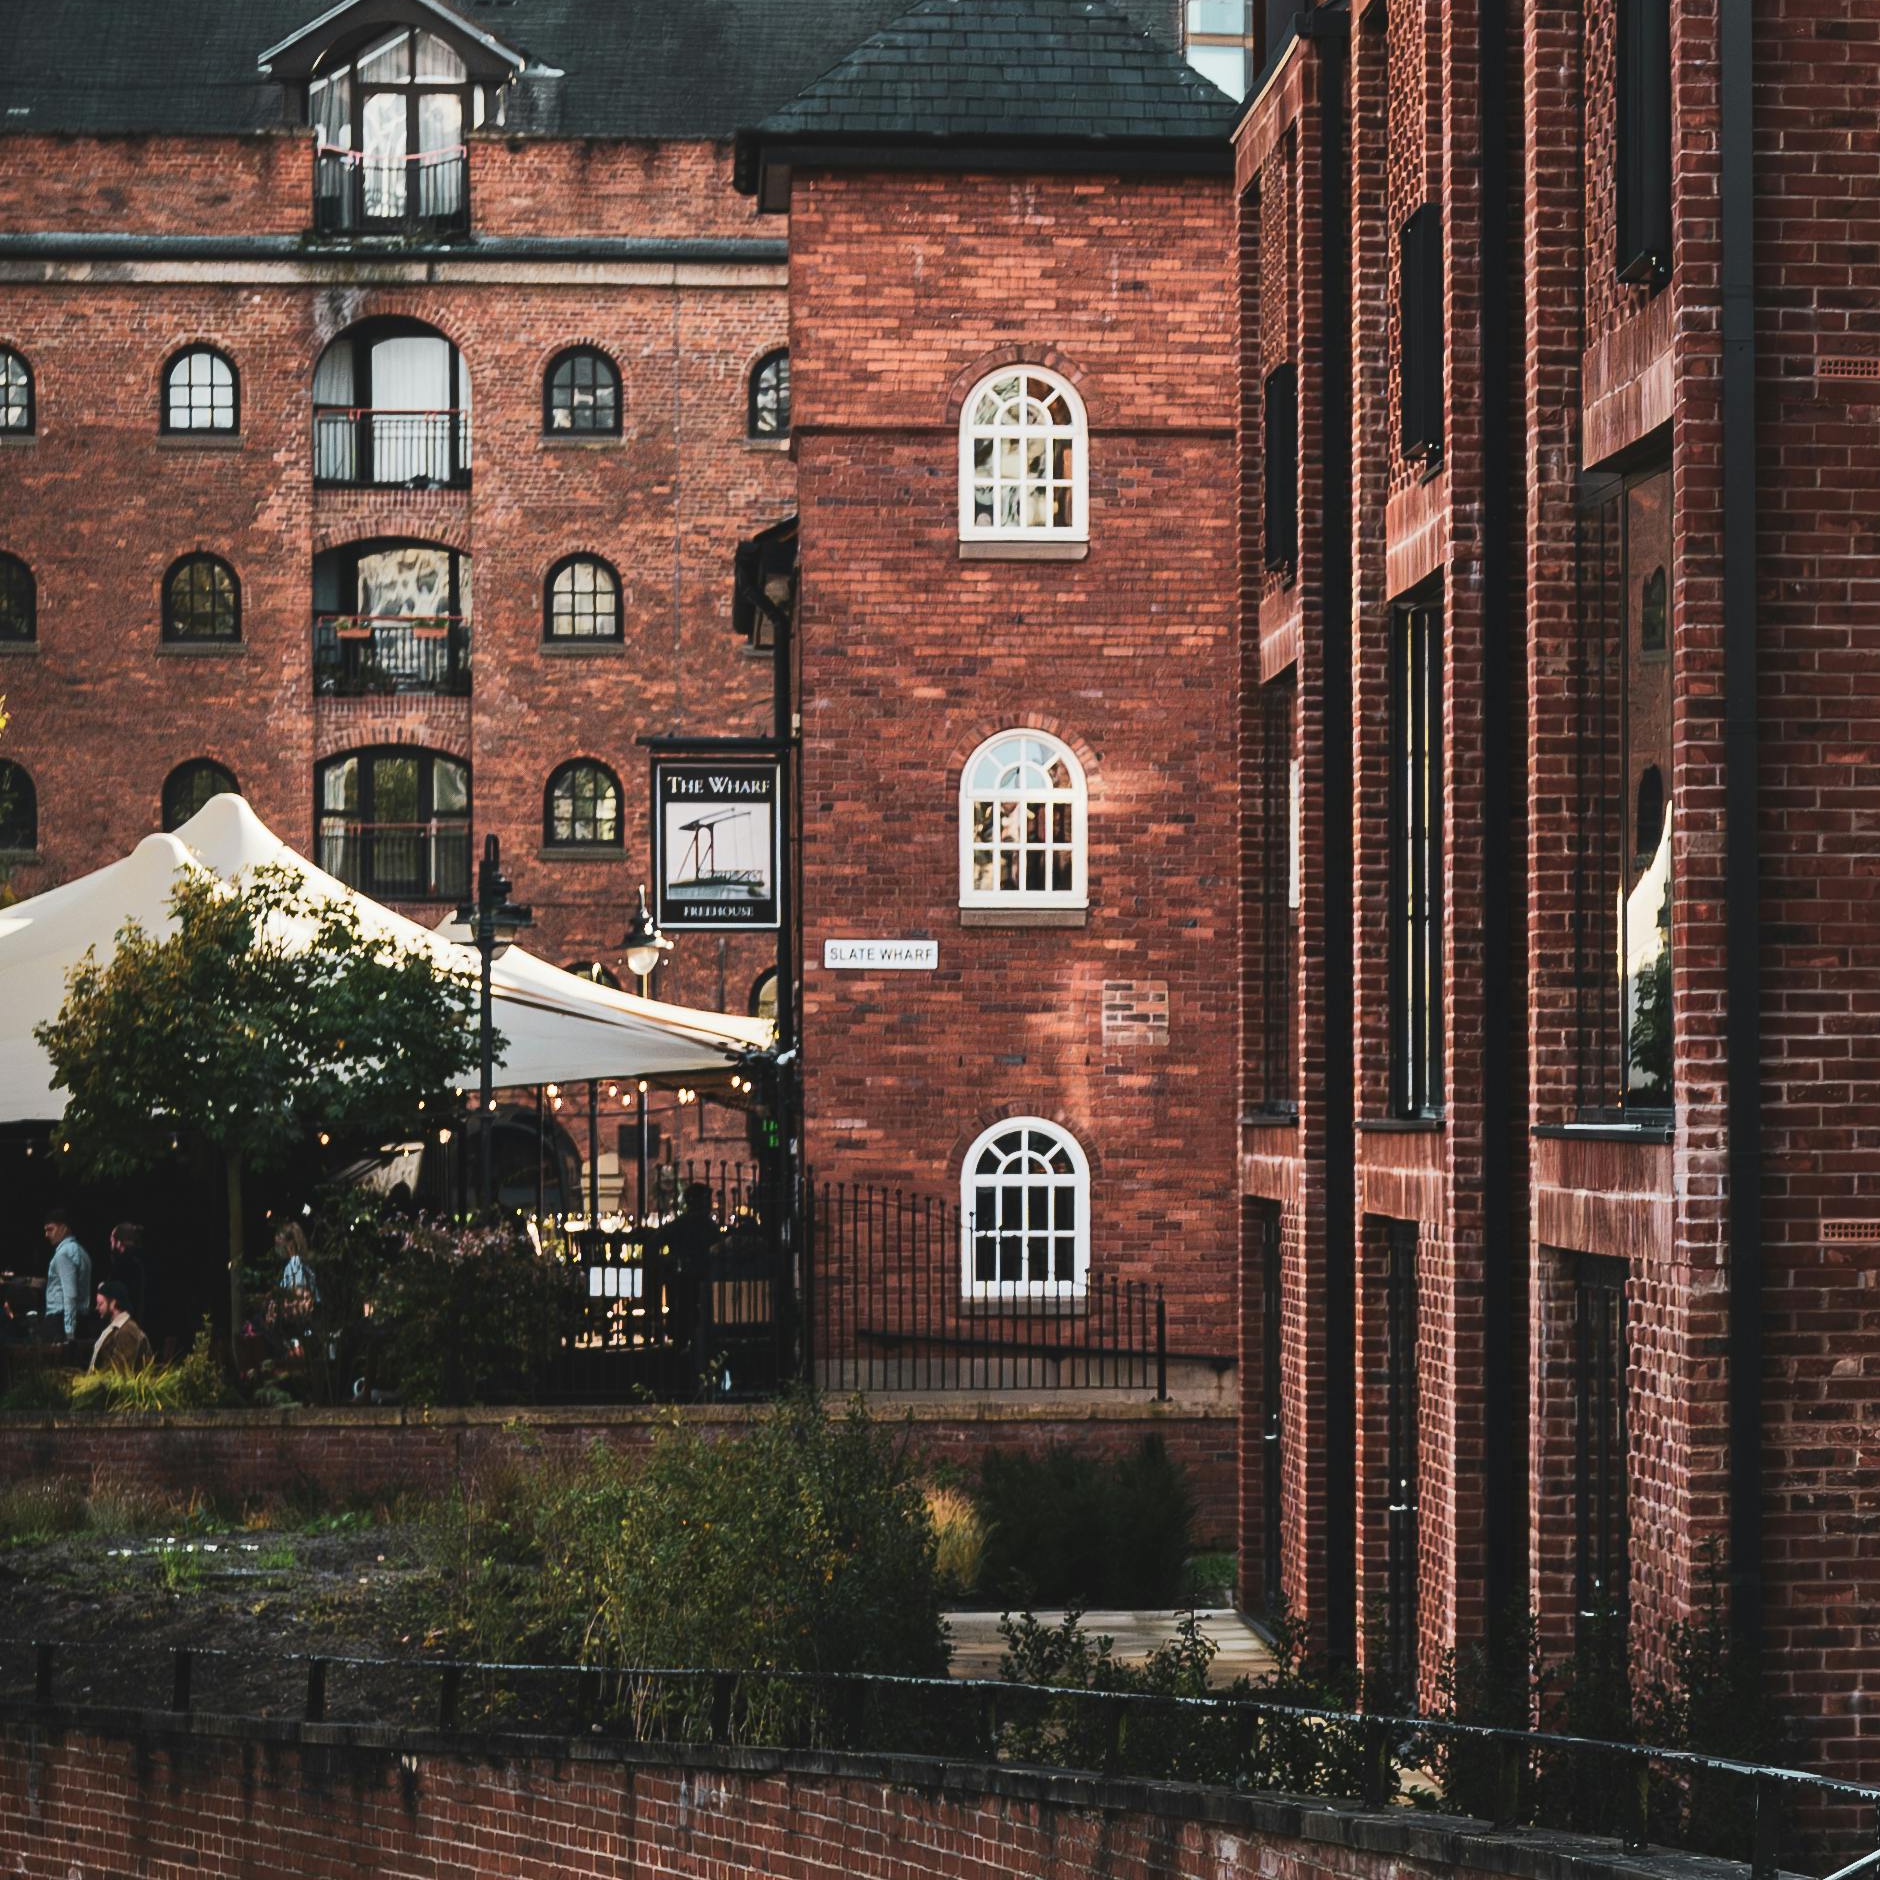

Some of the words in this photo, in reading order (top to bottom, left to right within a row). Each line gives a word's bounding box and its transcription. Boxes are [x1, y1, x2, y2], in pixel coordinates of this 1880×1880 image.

[666, 775, 704, 794] THE
[708, 775, 770, 794] WHARF
[683, 906, 753, 917] FREEHOUSE
[830, 947, 875, 961] SLATE
[879, 947, 932, 961] WHARF
